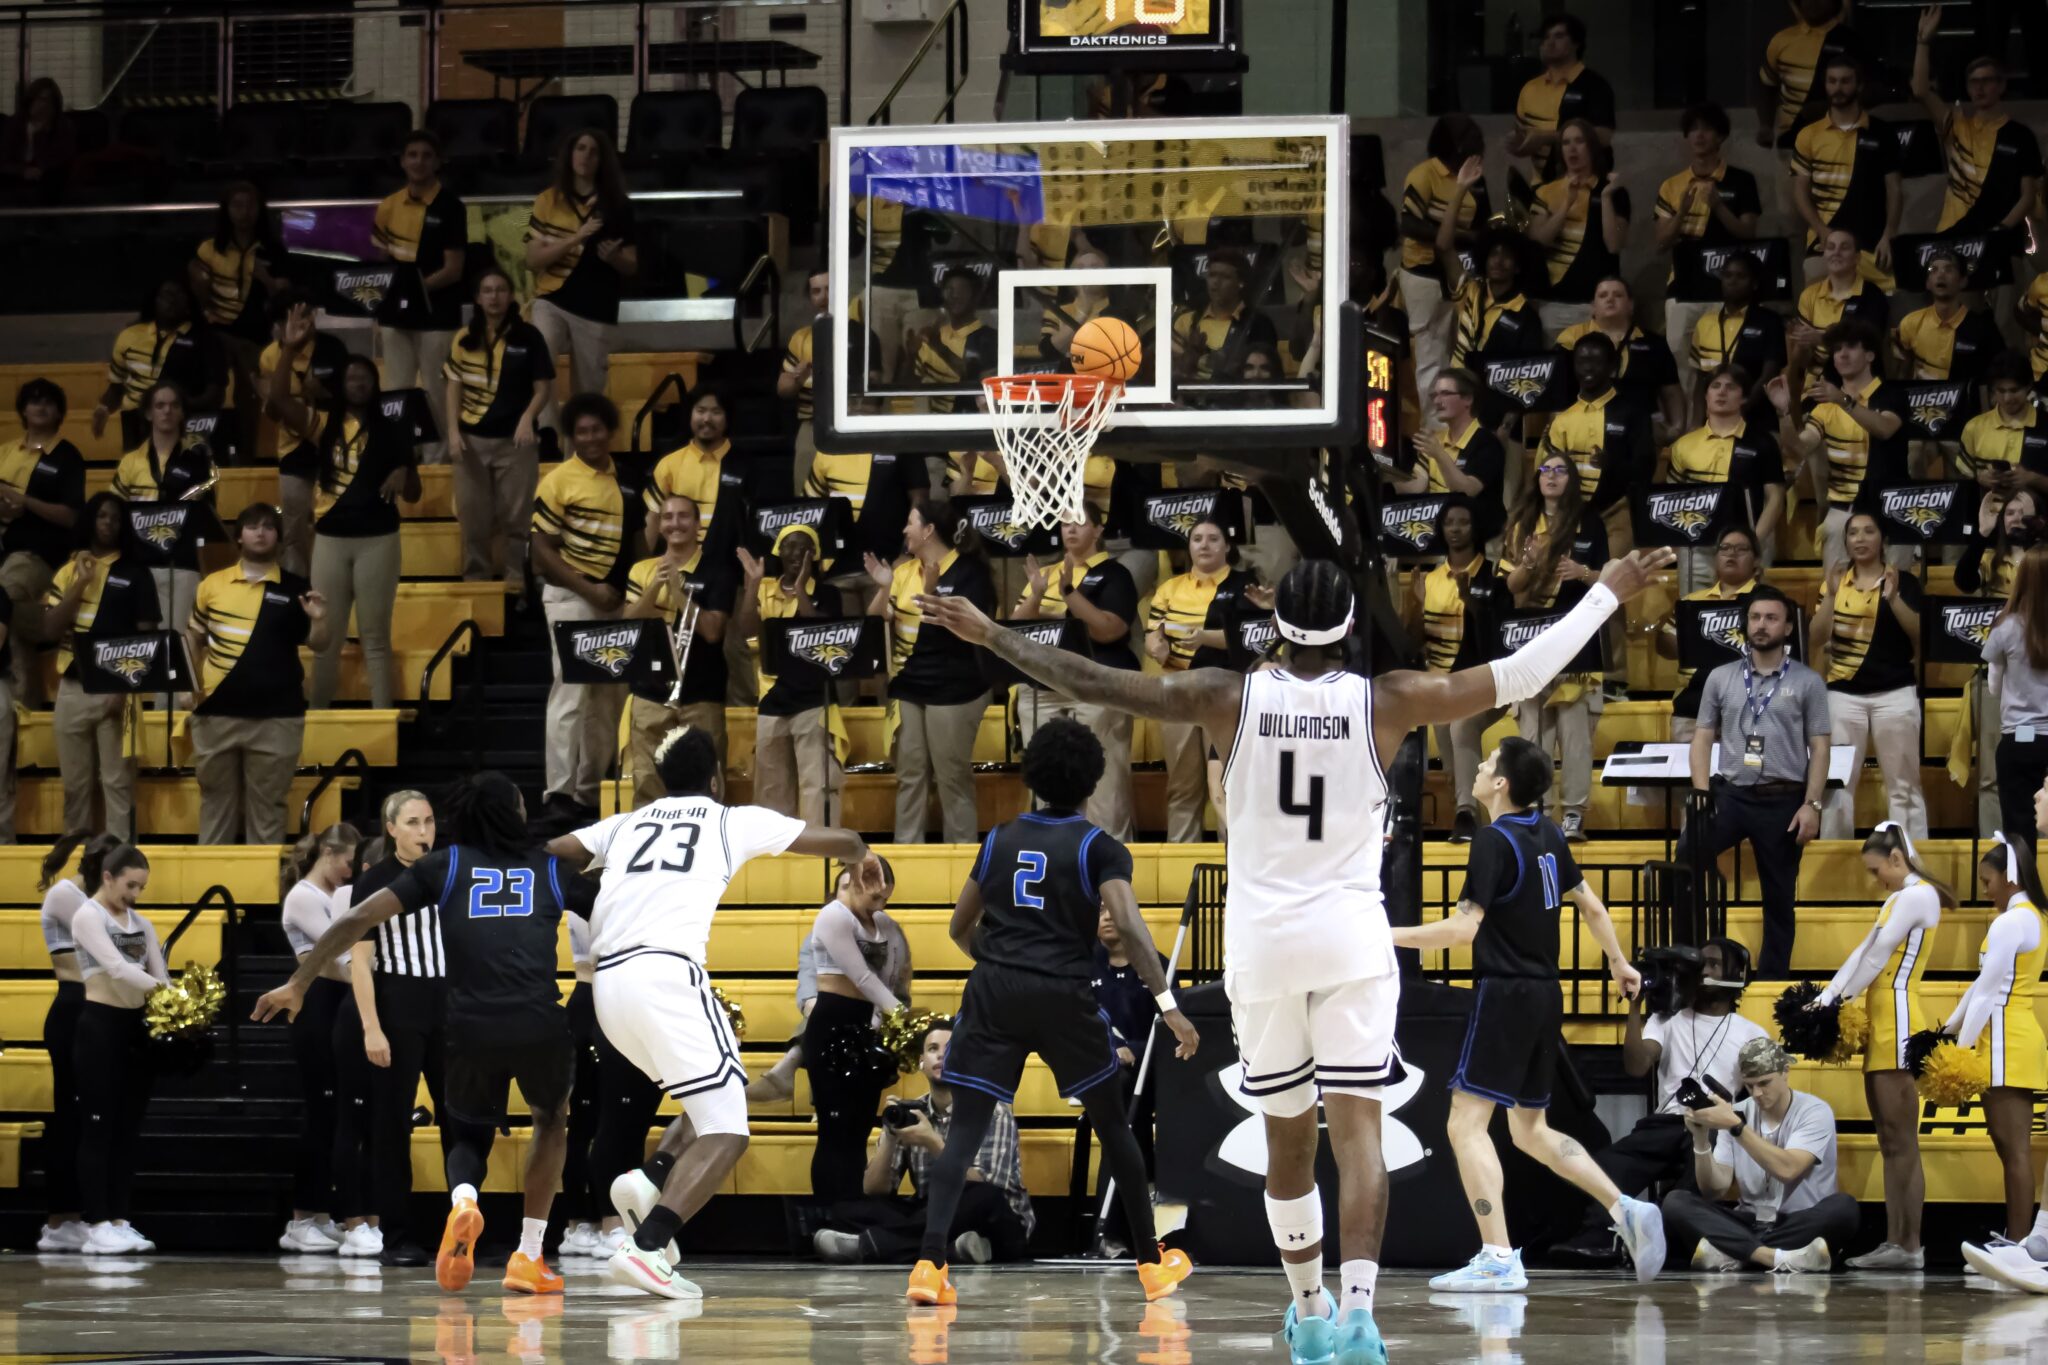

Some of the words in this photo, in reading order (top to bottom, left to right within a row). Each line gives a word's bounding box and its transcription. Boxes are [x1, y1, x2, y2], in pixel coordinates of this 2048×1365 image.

[1070, 35, 1168, 46] DAKTRONICS
[336, 272, 393, 292] TOWSON
[1487, 362, 1553, 386] TOWSON
[1909, 389, 1959, 408] WSON
[186, 417, 217, 432] SON
[1147, 498, 1214, 522] TOWSON
[1308, 477, 1342, 546] Schelde
[1382, 503, 1444, 526] TOWSON
[1650, 493, 1718, 520] TOWSON
[1883, 491, 1953, 515] TOWSON
[131, 509, 187, 530] TOWSON
[759, 508, 825, 532] TOWSON
[970, 508, 1013, 530] TOWS
[1701, 613, 1740, 637] TOW
[1945, 608, 2001, 632] TOWS
[574, 628, 640, 656] TOWSON
[788, 627, 859, 654] TOWSON
[1021, 628, 1061, 647] SON
[1243, 623, 1277, 647] TOW
[96, 641, 158, 666] TOWSON
[1259, 712, 1350, 740] WILLIAMSON
[1279, 750, 1324, 841] 4
[626, 822, 701, 874] 23
[1013, 850, 1048, 910] 2
[1537, 852, 1559, 910] 11
[468, 866, 535, 919] 23
